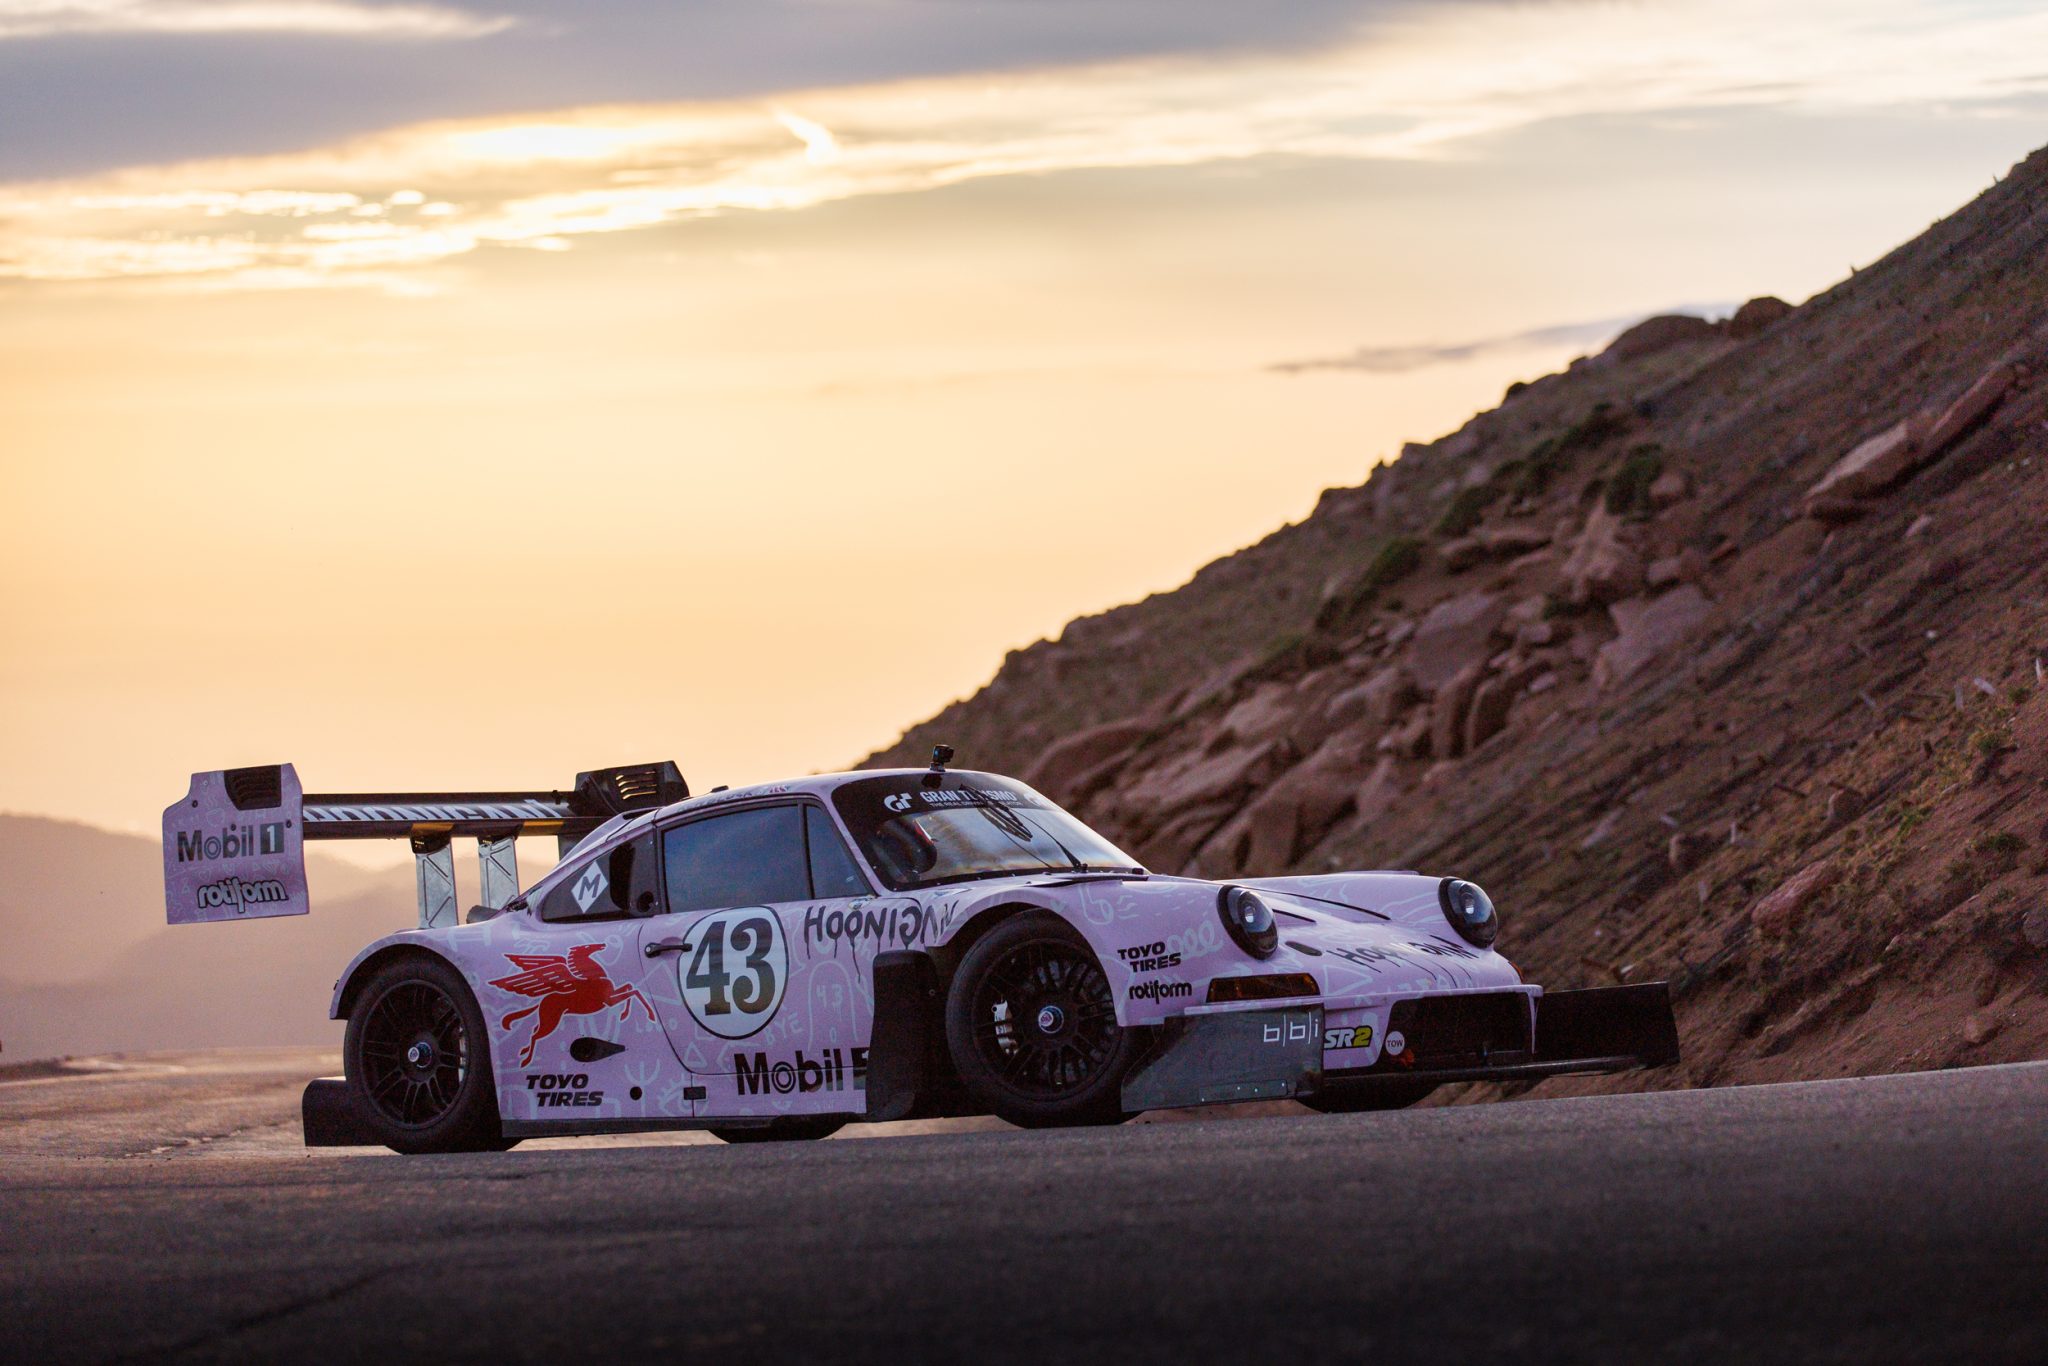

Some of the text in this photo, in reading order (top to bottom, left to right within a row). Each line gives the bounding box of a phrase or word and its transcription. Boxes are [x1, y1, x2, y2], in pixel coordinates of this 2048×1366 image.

[920, 790, 961, 803] GRAN
[958, 789, 1018, 802] TUISMO
[177, 825, 254, 862] Mobil
[197, 876, 289, 913] rotiform
[578, 873, 602, 901] M
[1117, 941, 1166, 960] TOYO
[686, 917, 776, 1016] 43
[1129, 952, 1182, 973] TIRES
[1128, 980, 1193, 1005] rotiform
[1387, 1039, 1403, 1047] TOW
[526, 1073, 590, 1090] TOYO
[733, 1048, 844, 1096] Mobil
[536, 1090, 604, 1107] TIRES
